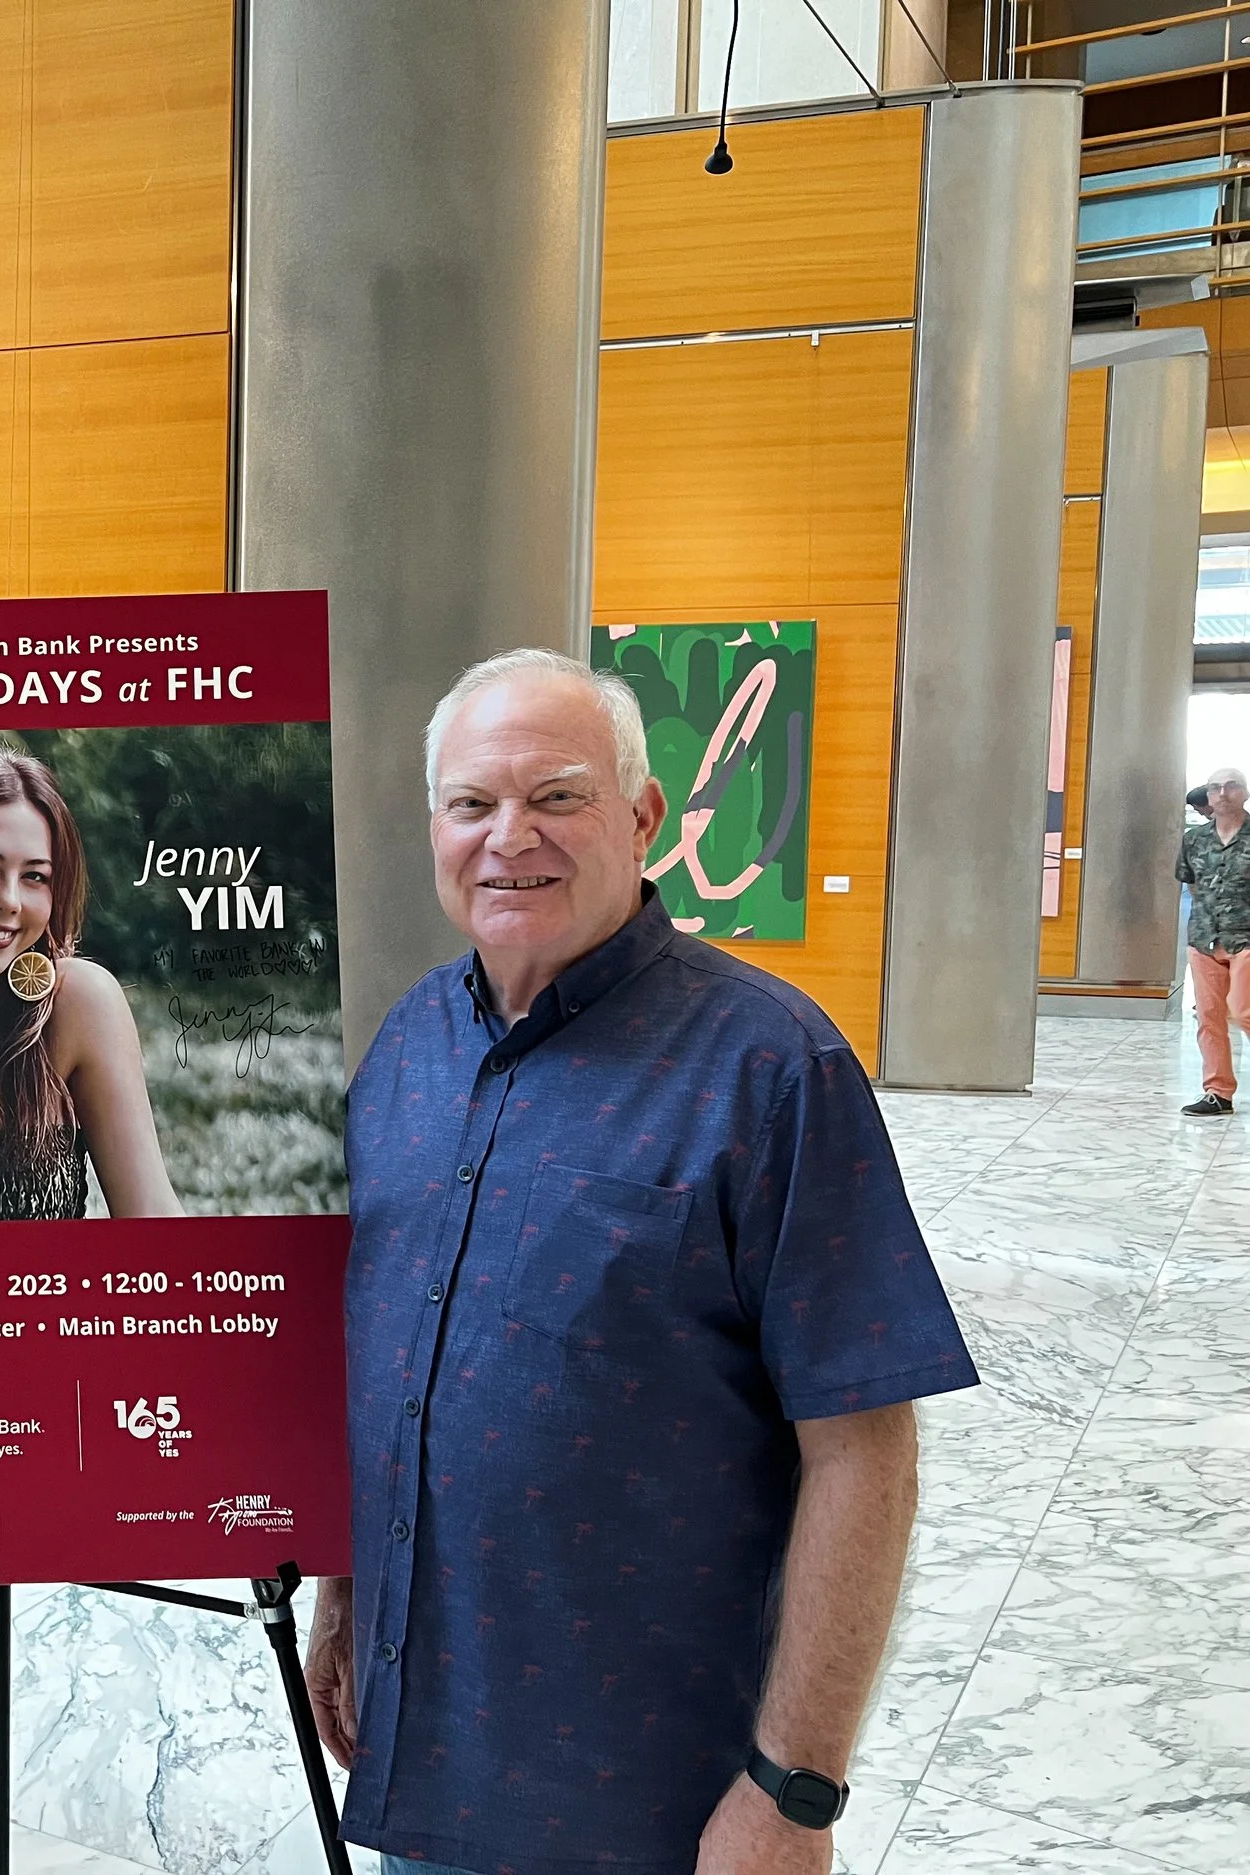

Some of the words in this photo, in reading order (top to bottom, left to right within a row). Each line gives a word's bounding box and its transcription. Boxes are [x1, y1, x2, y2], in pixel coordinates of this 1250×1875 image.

[18, 635, 81, 656] Bank
[89, 633, 199, 654] Presents
[118, 678, 152, 702] at
[167, 665, 253, 701] FHC
[133, 840, 262, 887] Jenny
[176, 885, 284, 931] YIM
[191, 945, 252, 965] FAVORITE
[7, 1273, 67, 1296] 2023
[101, 1271, 168, 1294] 12:00
[191, 1270, 285, 1298] 1:00pm
[59, 1315, 115, 1336] Main
[122, 1314, 203, 1335] Branch
[210, 1313, 279, 1338] Lobby
[113, 1396, 181, 1439] 165
[157, 1430, 193, 1439] YEARS
[158, 1439, 173, 1449] OF
[158, 1448, 180, 1458] YES
[235, 1494, 271, 1510] HENRY
[116, 1510, 165, 1523] Supported
[165, 1510, 178, 1523] by
[179, 1509, 195, 1520] the
[237, 1517, 294, 1527] FOUNDATION
